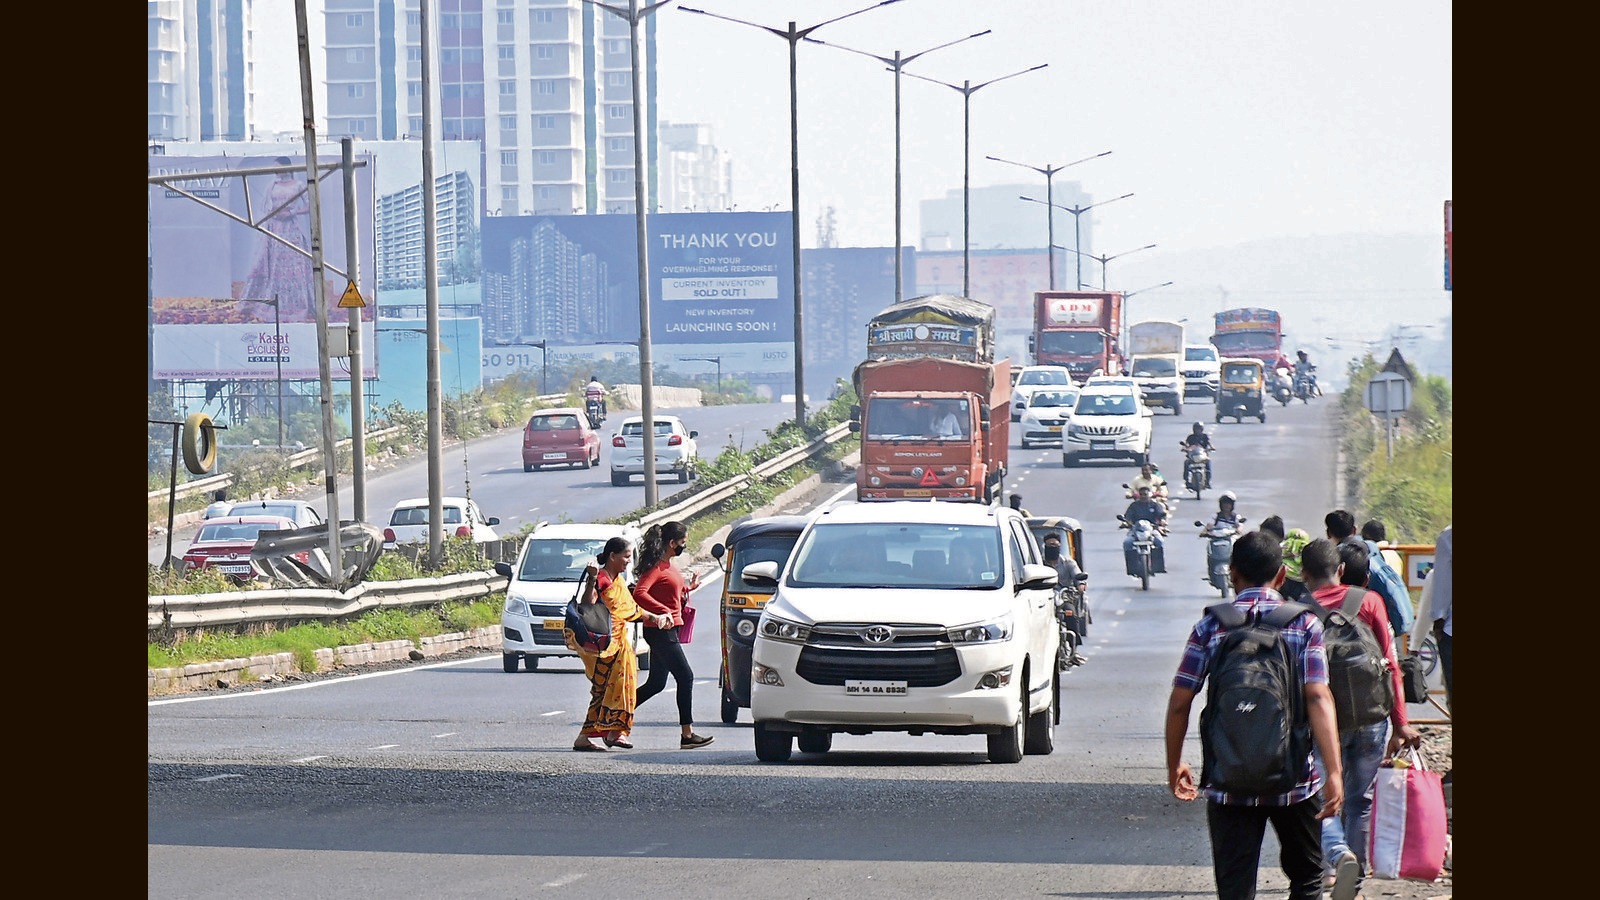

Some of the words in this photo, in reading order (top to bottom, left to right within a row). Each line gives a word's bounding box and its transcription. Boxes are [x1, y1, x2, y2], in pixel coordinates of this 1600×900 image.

[660, 233, 728, 248] THANK
[734, 232, 777, 247] YOU
[694, 289, 718, 297] SOLD
[666, 322, 733, 332] LAUNCHING
[736, 322, 770, 331] SOON
[259, 332, 289, 344] Kasat
[931, 329, 961, 341] समर्थ
[506, 354, 530, 366] 911
